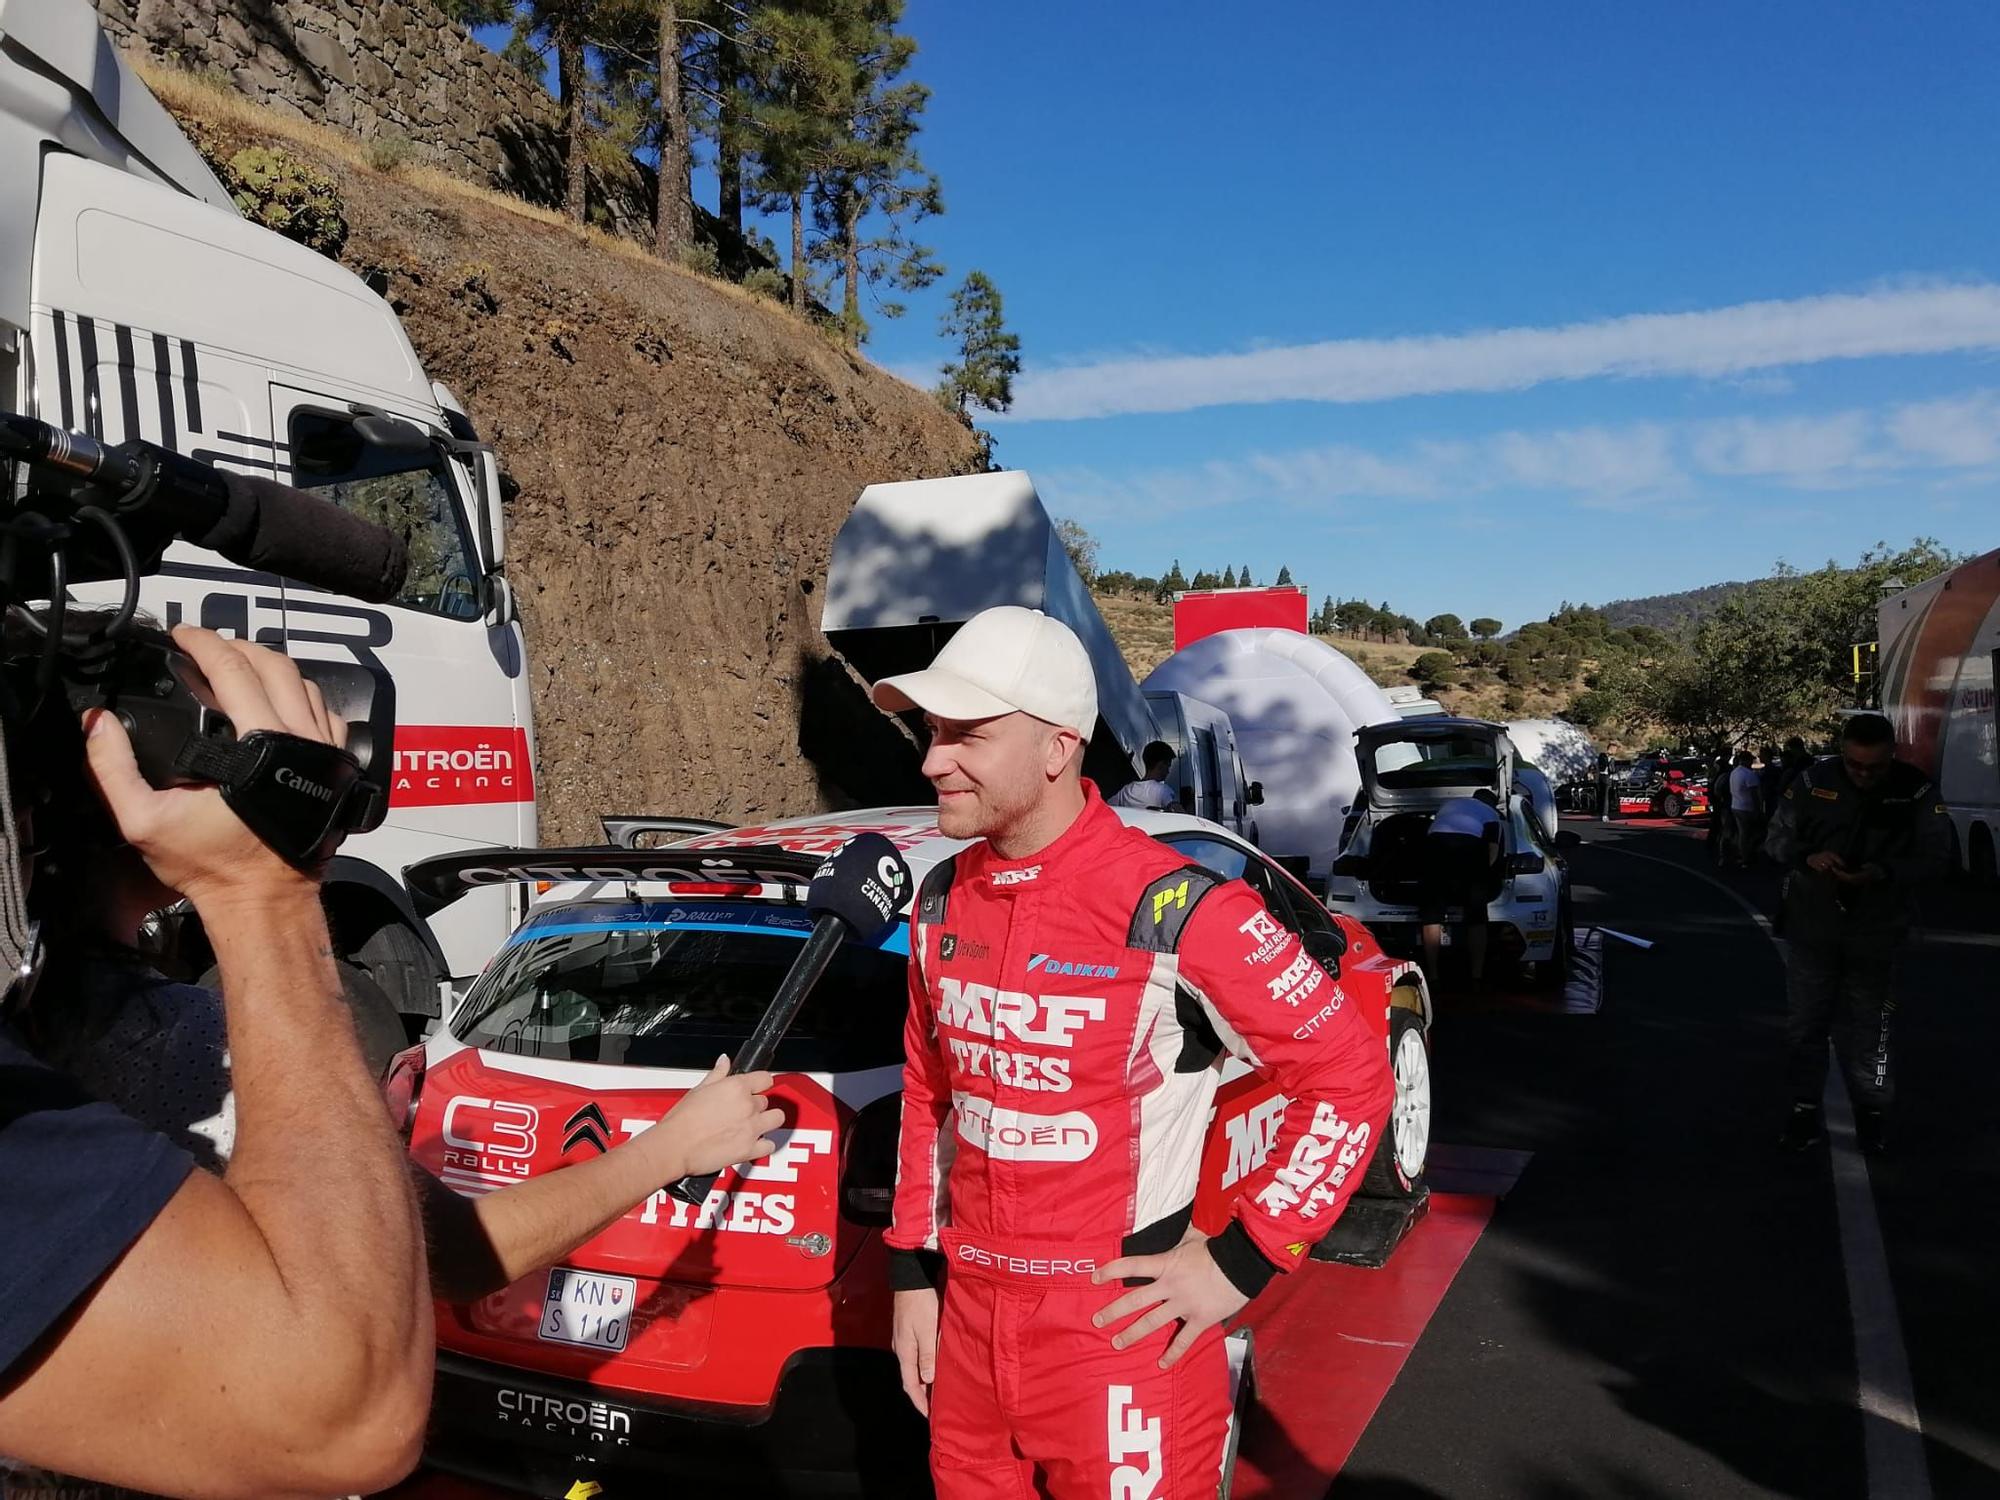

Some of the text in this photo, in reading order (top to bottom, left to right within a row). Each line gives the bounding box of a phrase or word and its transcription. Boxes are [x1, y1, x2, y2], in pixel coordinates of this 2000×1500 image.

[393, 744, 512, 771] ITROËN
[275, 767, 333, 802] Canon
[397, 776, 513, 790] ACING
[991, 865, 1043, 886] MRF
[1152, 879, 1190, 926] P1
[1045, 959, 1120, 979] DAIKIN
[1244, 938, 1275, 965] TAGAI
[937, 976, 1106, 1047] MRF
[1293, 985, 1345, 1040] CITROË
[949, 1037, 1073, 1093] TYRES
[442, 1095, 539, 1159] C3
[957, 1100, 1090, 1146] ITROËN
[1255, 1100, 1349, 1217] MRF
[1298, 1121, 1371, 1219] TYRES
[640, 1189, 796, 1236] TYRES
[957, 1244, 1096, 1276] ØSTBERG
[574, 1278, 606, 1306] KN
[549, 1308, 620, 1344] S 110
[497, 1389, 631, 1434] CITROËN
[1107, 1384, 1163, 1500] RF
